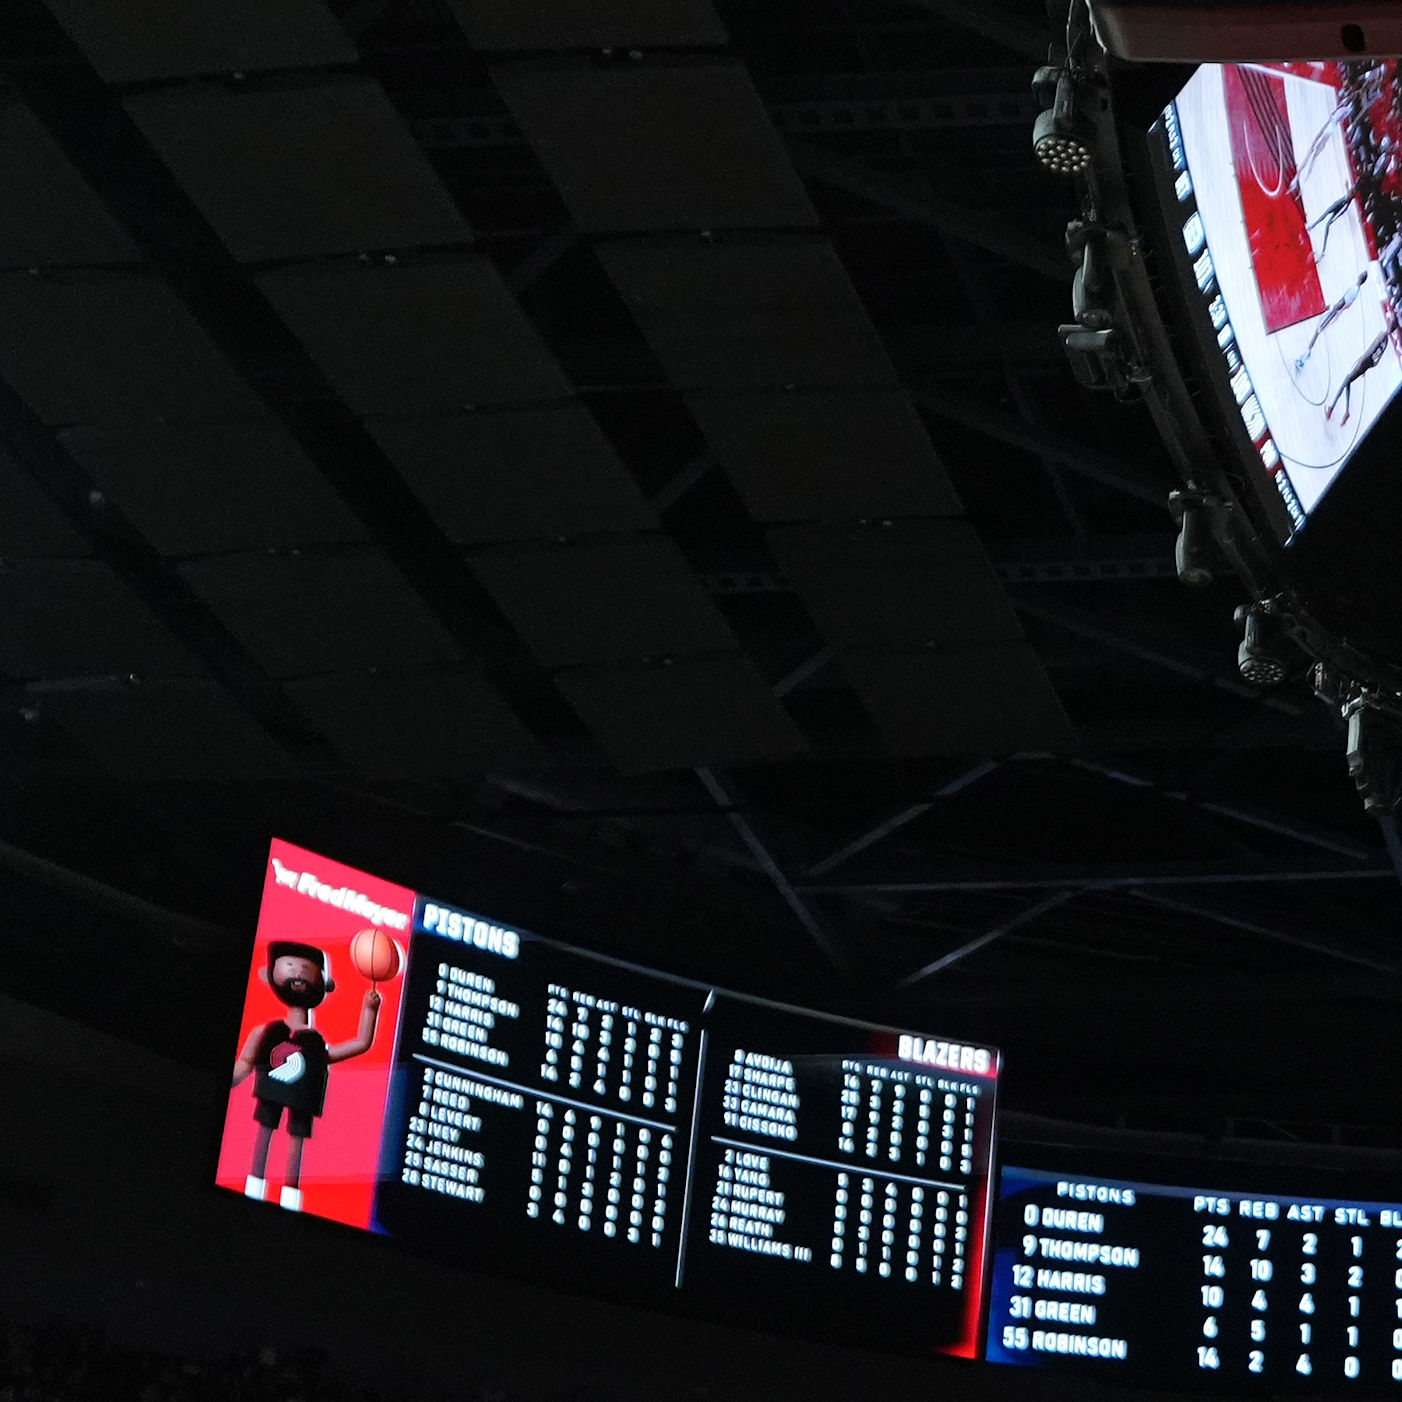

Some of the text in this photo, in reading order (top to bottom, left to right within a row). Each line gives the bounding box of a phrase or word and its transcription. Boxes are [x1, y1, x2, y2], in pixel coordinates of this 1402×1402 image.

[297, 872, 410, 930] FredMeyer
[423, 904, 520, 959] PISTONS
[898, 1035, 990, 1072] BLAZERS
[435, 1070, 524, 1110] CUNNINGHAM
[422, 1173, 485, 1203] STEWART
[1057, 1182, 1136, 1205] PISTONS
[1024, 1204, 1104, 1233] 0 DUREN
[1194, 1196, 1230, 1215] PTS
[1239, 1200, 1279, 1220] REB
[1287, 1205, 1325, 1222] AST
[1335, 1208, 1370, 1226] STL
[728, 1232, 793, 1260] WILLIAMS
[794, 1246, 812, 1263] III
[1023, 1234, 1140, 1268] 9 THOMPSON
[1012, 1264, 1106, 1295] 12 HARRIS
[1010, 1295, 1096, 1325] 31 GREEN
[1003, 1326, 1127, 1359] 55 ROBINSON
